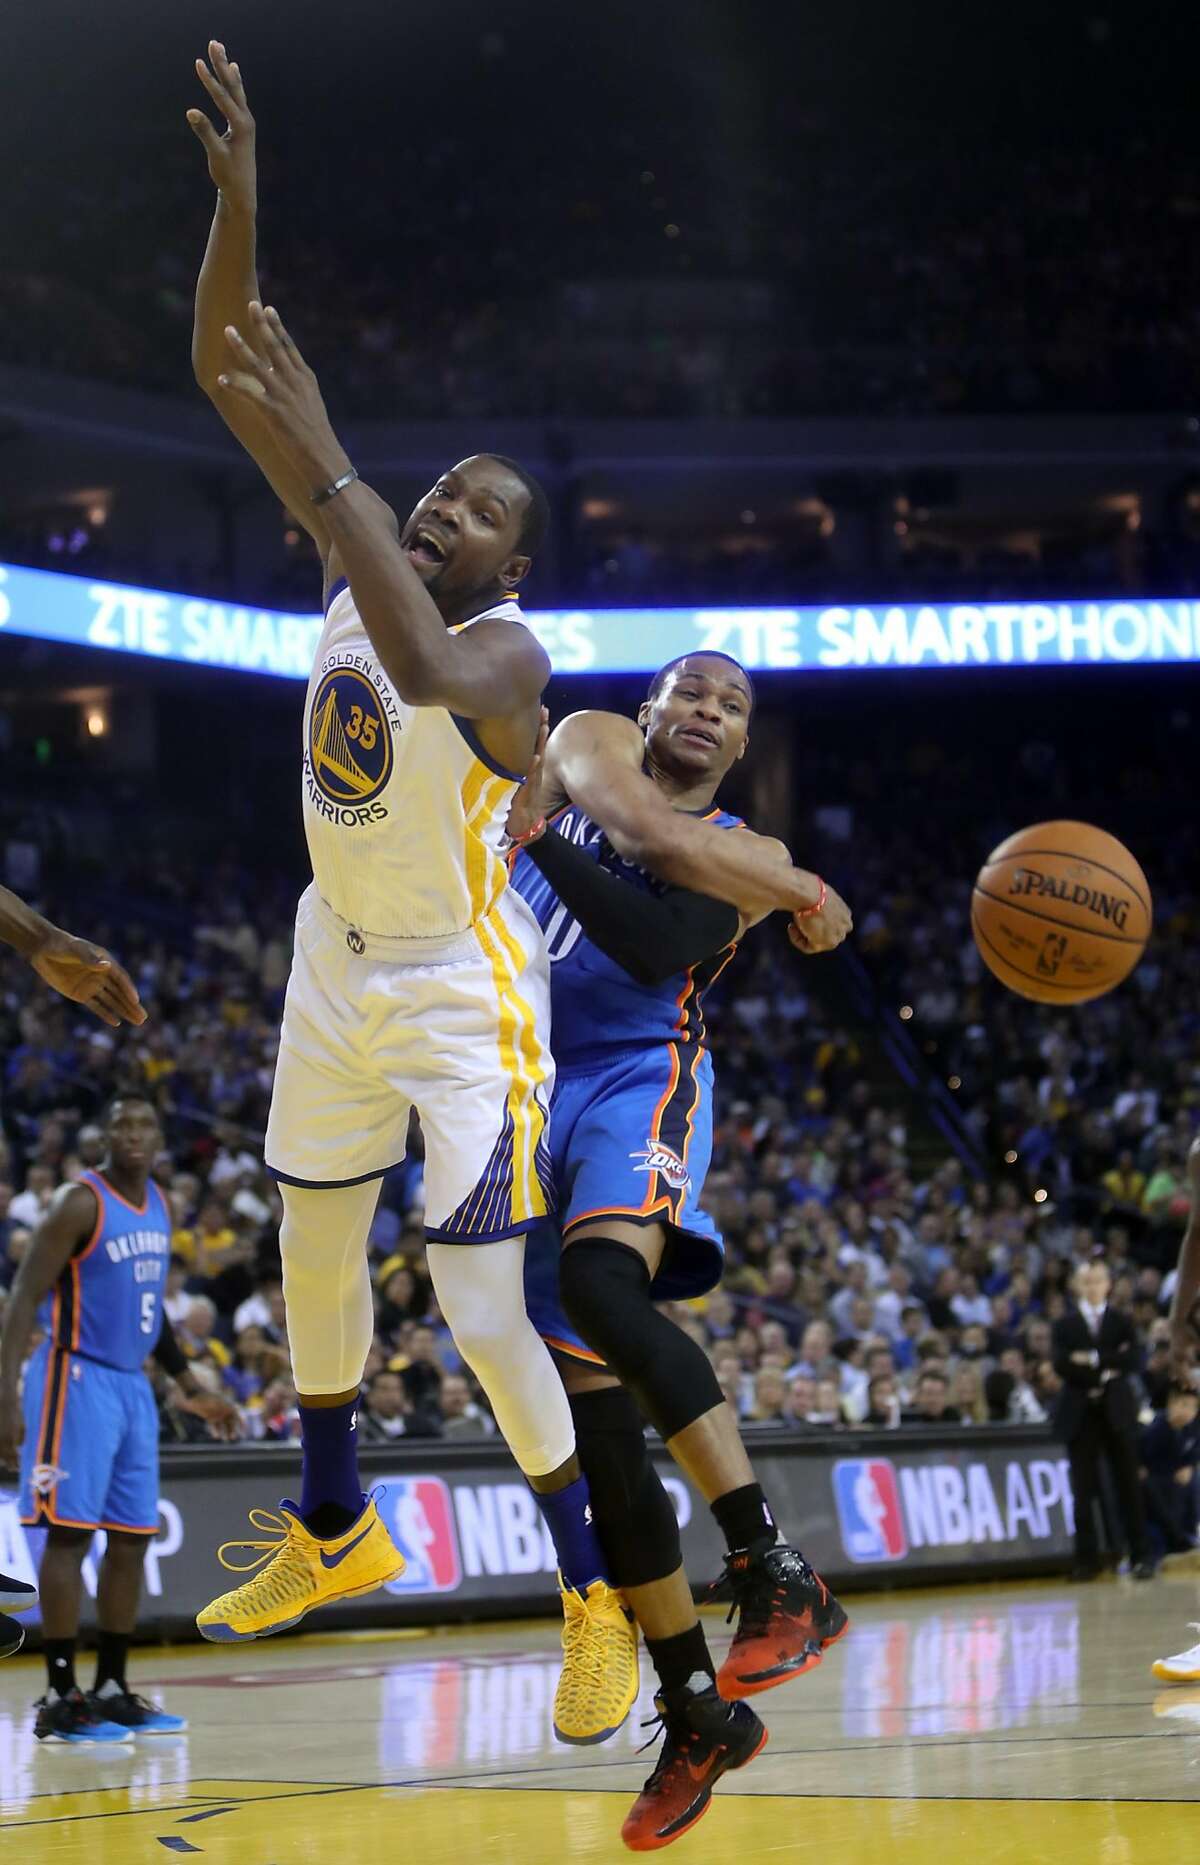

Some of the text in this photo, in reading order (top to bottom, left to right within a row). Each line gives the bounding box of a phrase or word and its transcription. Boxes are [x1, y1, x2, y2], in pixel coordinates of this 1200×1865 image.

[87, 585, 171, 655] ZTE
[693, 609, 801, 668] ZTE
[321, 653, 402, 733] GOLDEN STATE
[345, 704, 380, 751] 35
[303, 750, 389, 828] WARRIORS
[1009, 867, 1130, 932] SPALDING
[140, 1291, 156, 1334] 5
[899, 1462, 1006, 1548] NBA
